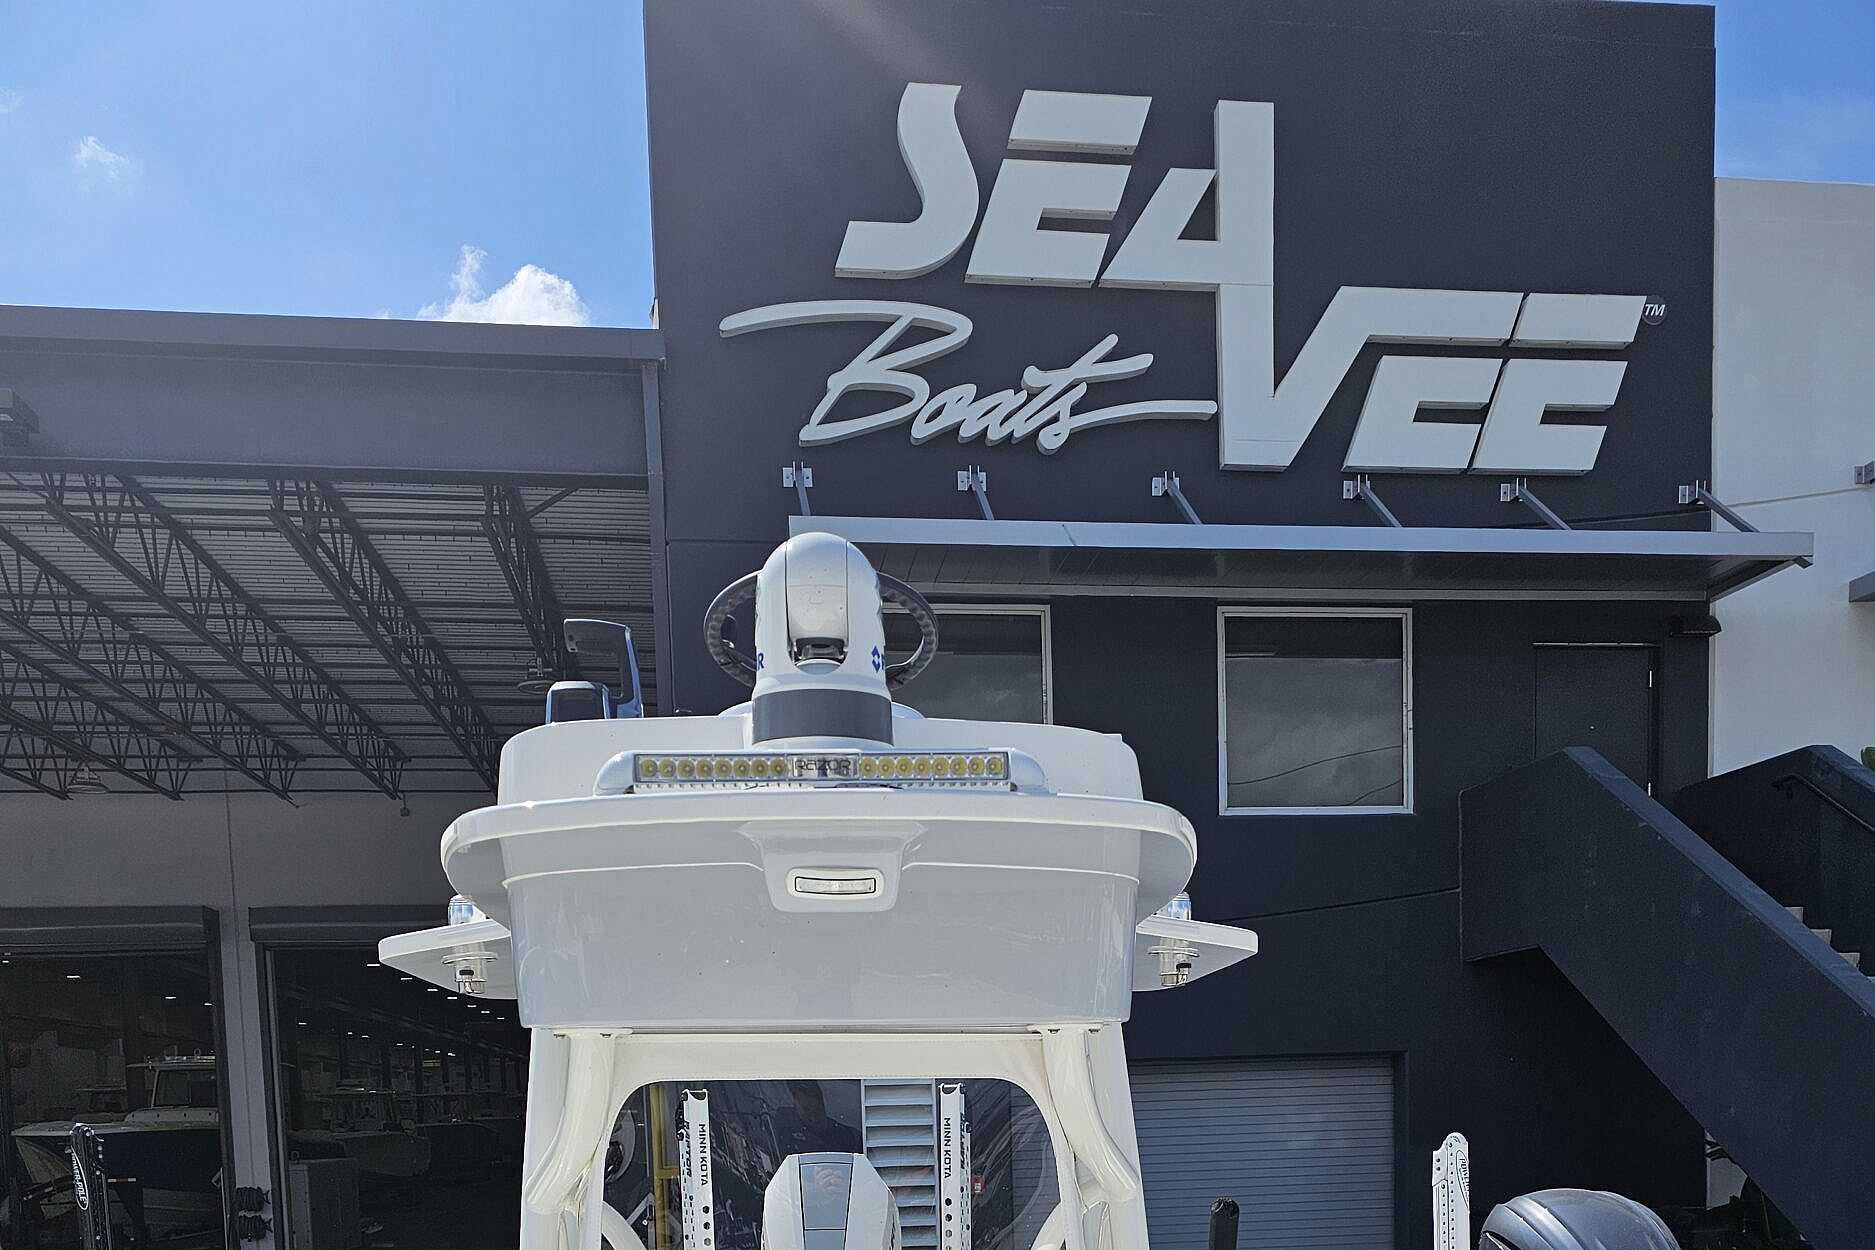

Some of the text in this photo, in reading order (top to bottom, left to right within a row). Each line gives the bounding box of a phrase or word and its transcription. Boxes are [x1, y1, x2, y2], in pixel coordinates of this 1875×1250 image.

[835, 82, 1275, 292] SEA
[719, 299, 1218, 456] Boats
[698, 1123, 709, 1186] MINN KOTA
[943, 1116, 952, 1179] MINN KOTA
